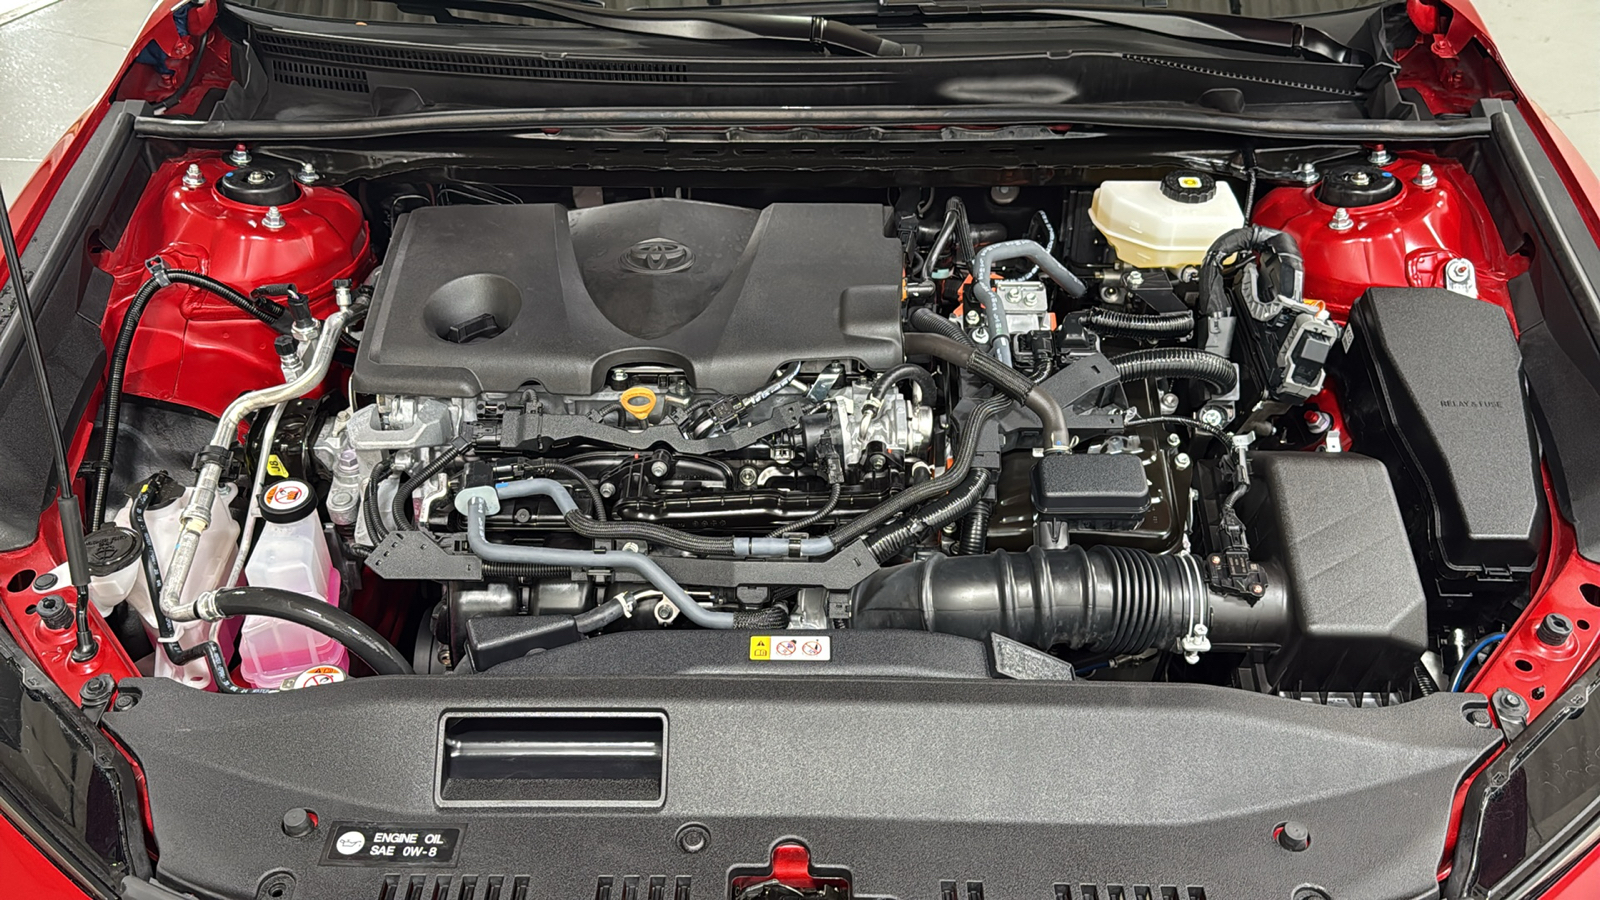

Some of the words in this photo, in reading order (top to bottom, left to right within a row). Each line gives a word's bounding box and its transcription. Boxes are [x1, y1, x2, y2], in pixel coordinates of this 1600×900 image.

[1440, 400, 1469, 408] RELAY
[1478, 401, 1503, 409] FUSE
[269, 460, 281, 472] J8
[373, 832, 419, 844] ENGINE
[424, 833, 444, 845] OIL
[369, 845, 396, 856] SAE
[402, 846, 438, 857] 0W-8
